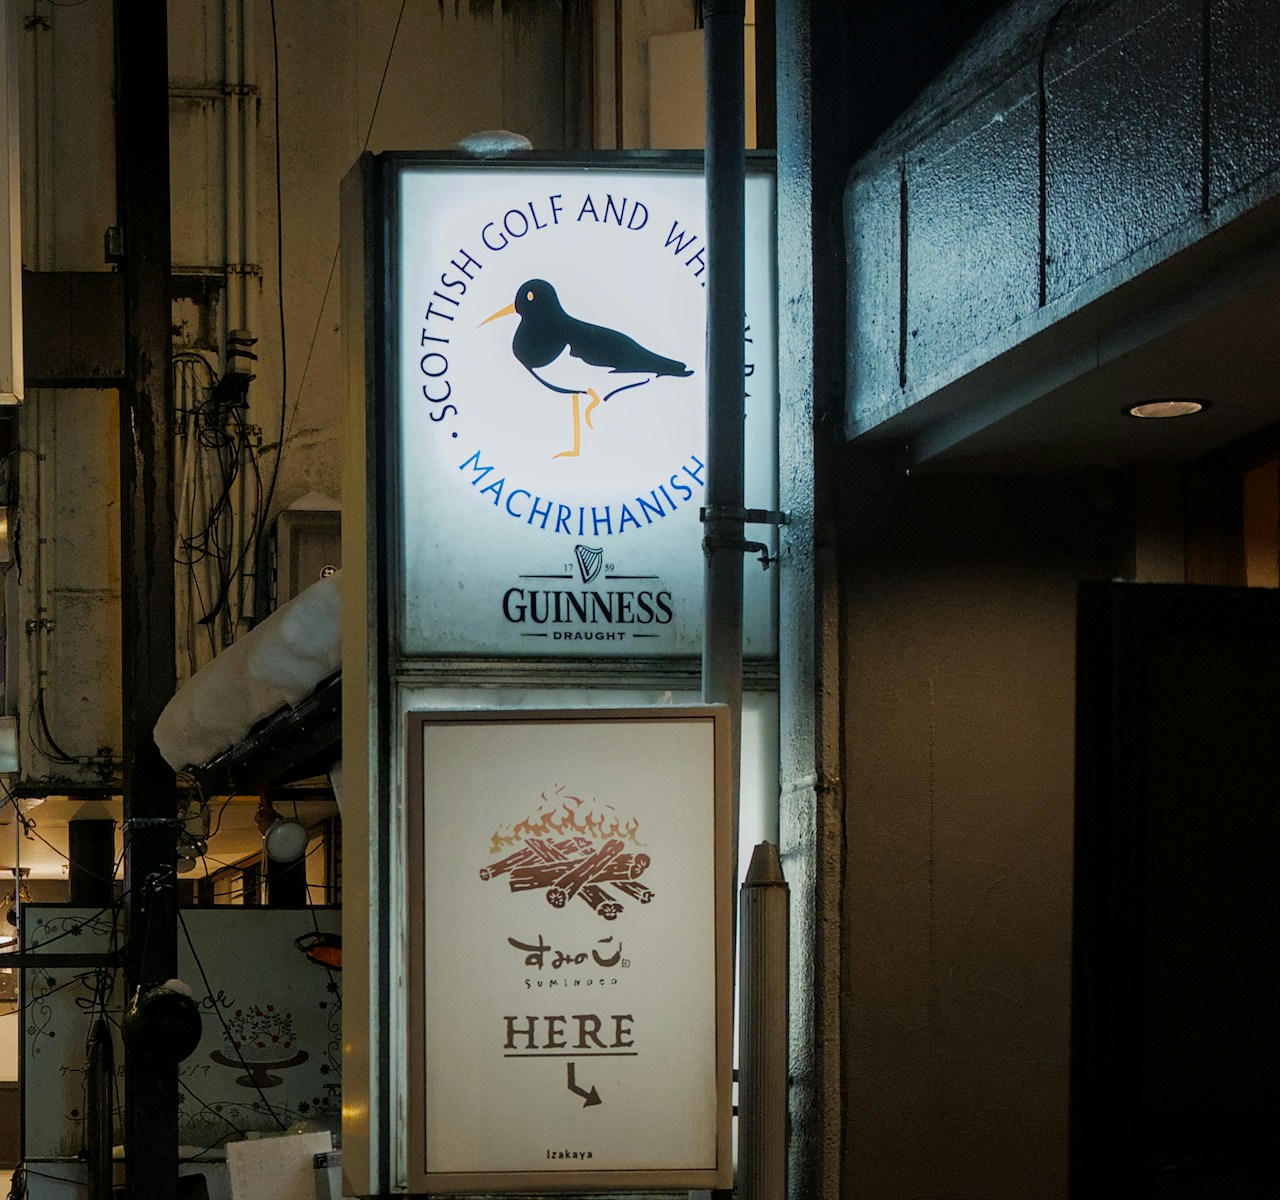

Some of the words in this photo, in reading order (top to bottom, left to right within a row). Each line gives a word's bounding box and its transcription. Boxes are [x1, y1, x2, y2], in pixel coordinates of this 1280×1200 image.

[419, 248, 483, 422] SCOTTISH
[481, 194, 563, 253] GOLF
[576, 193, 650, 232] AND
[563, 563, 574, 573] 17
[604, 563, 615, 573] 59
[503, 588, 673, 625] GUINNESS
[553, 631, 626, 642] DRAUGHT
[503, 1014, 636, 1050] HERE
[546, 1149, 594, 1162] Izakaya
